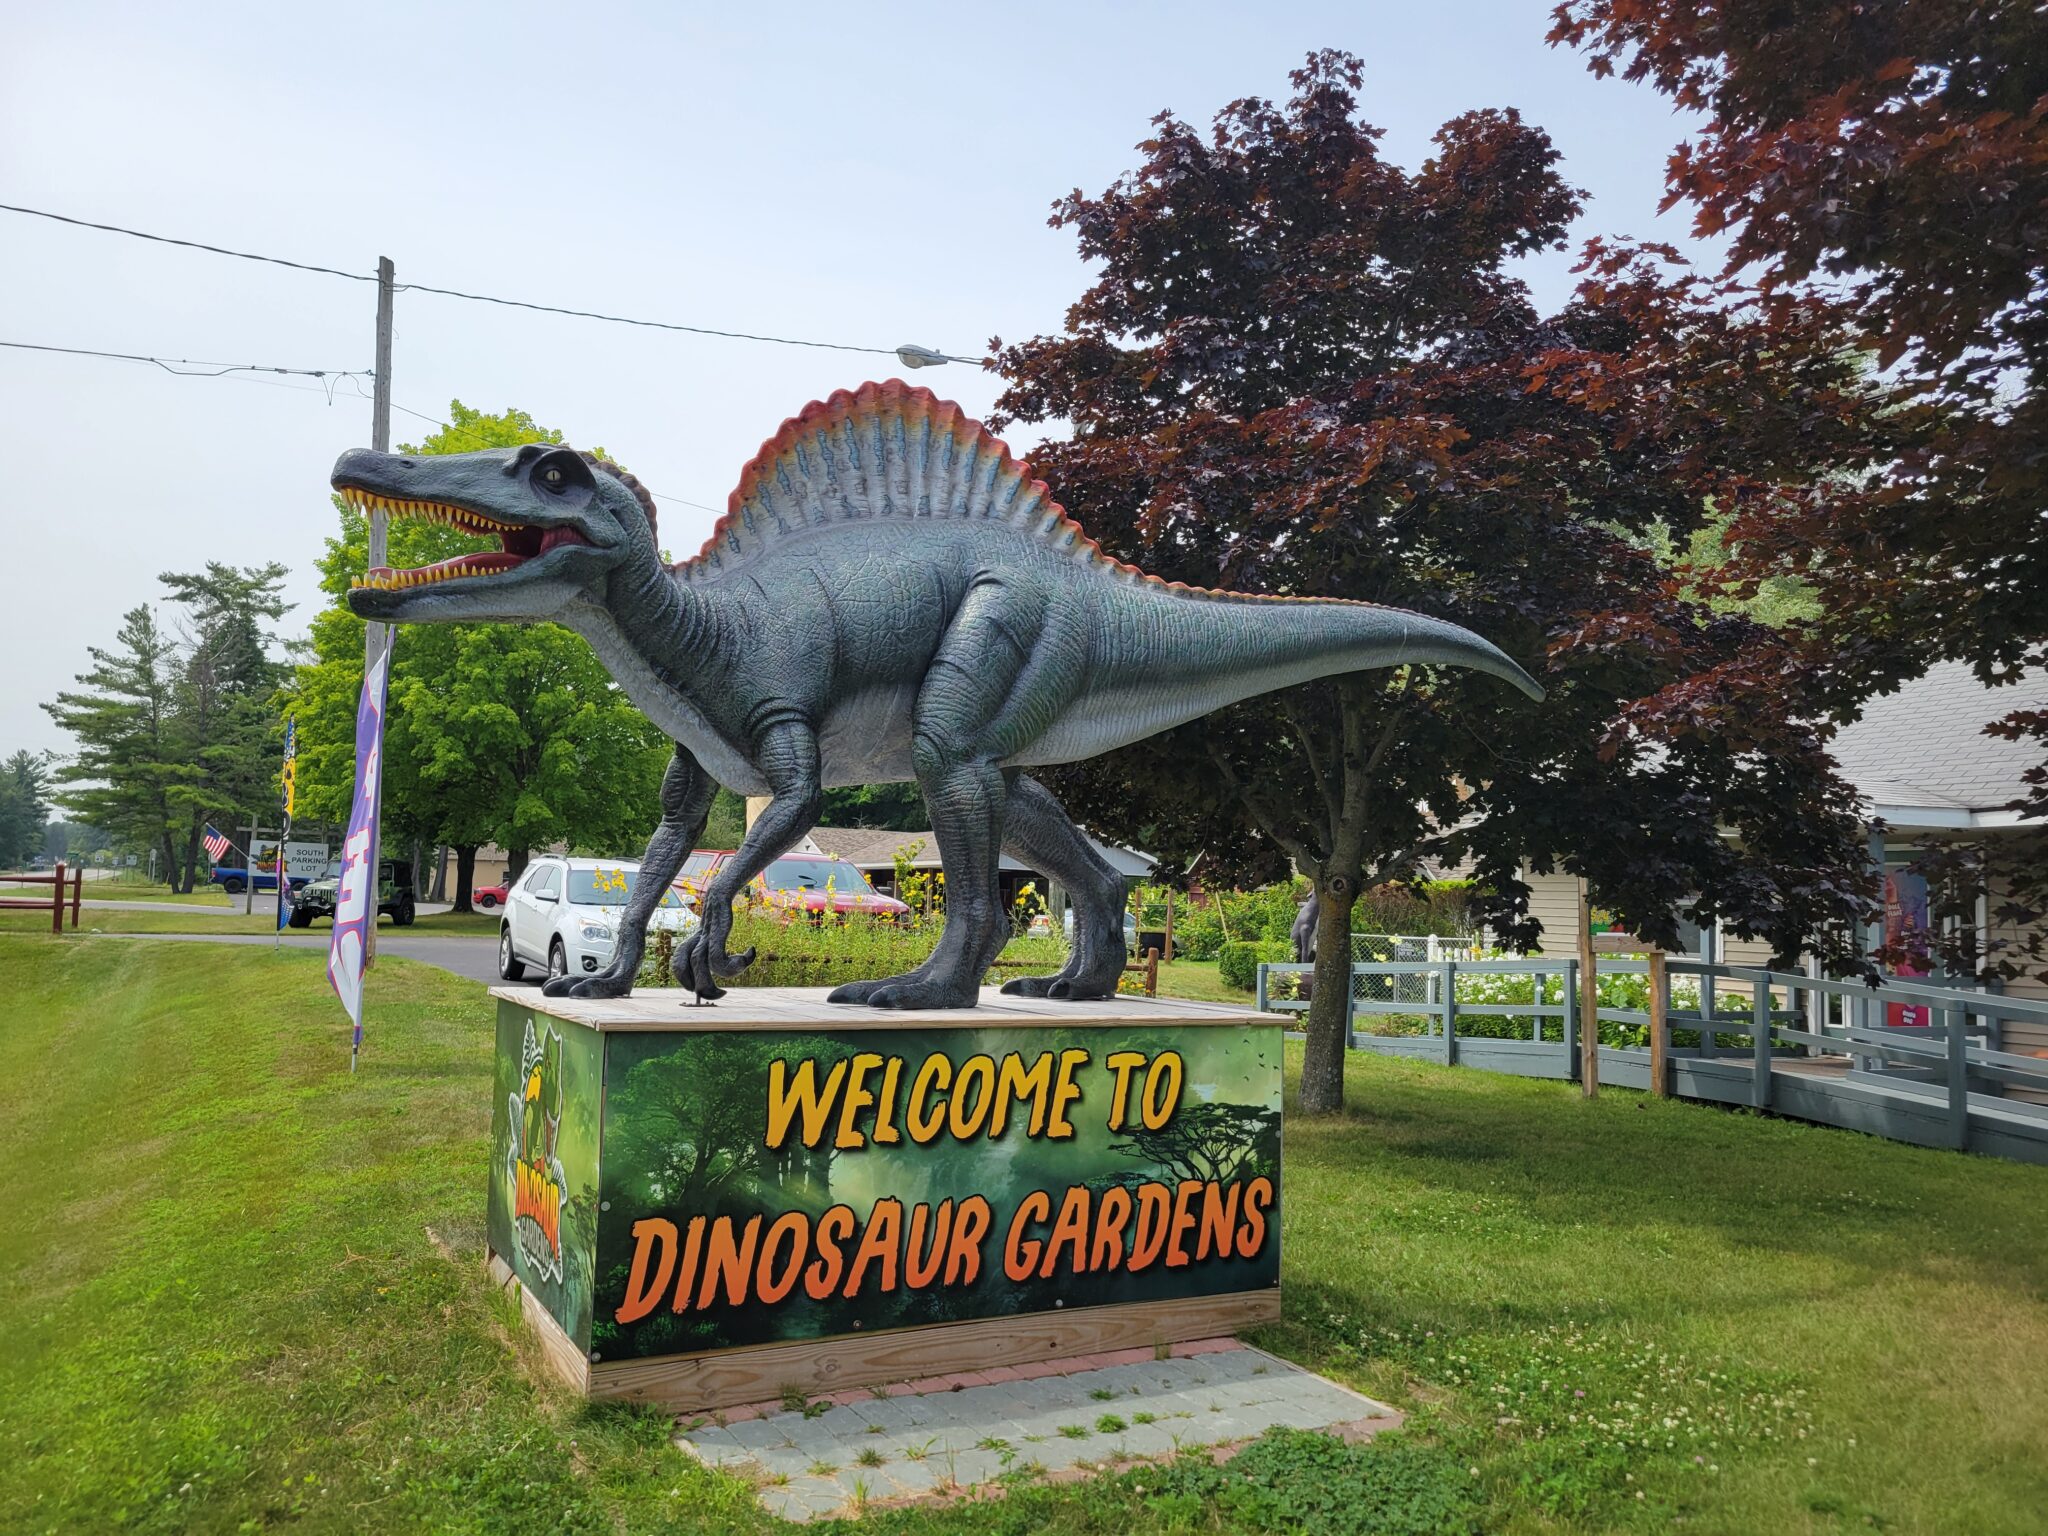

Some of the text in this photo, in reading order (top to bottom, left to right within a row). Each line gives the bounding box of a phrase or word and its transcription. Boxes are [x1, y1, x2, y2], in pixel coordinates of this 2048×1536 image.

[291, 856, 327, 865] PARKING
[296, 849, 324, 857] SOUTH
[764, 1047, 1184, 1151] WELCOME TO
[515, 1157, 559, 1263] DINOSAUR
[615, 1176, 1274, 1326] DINOSAUR GARDENS
